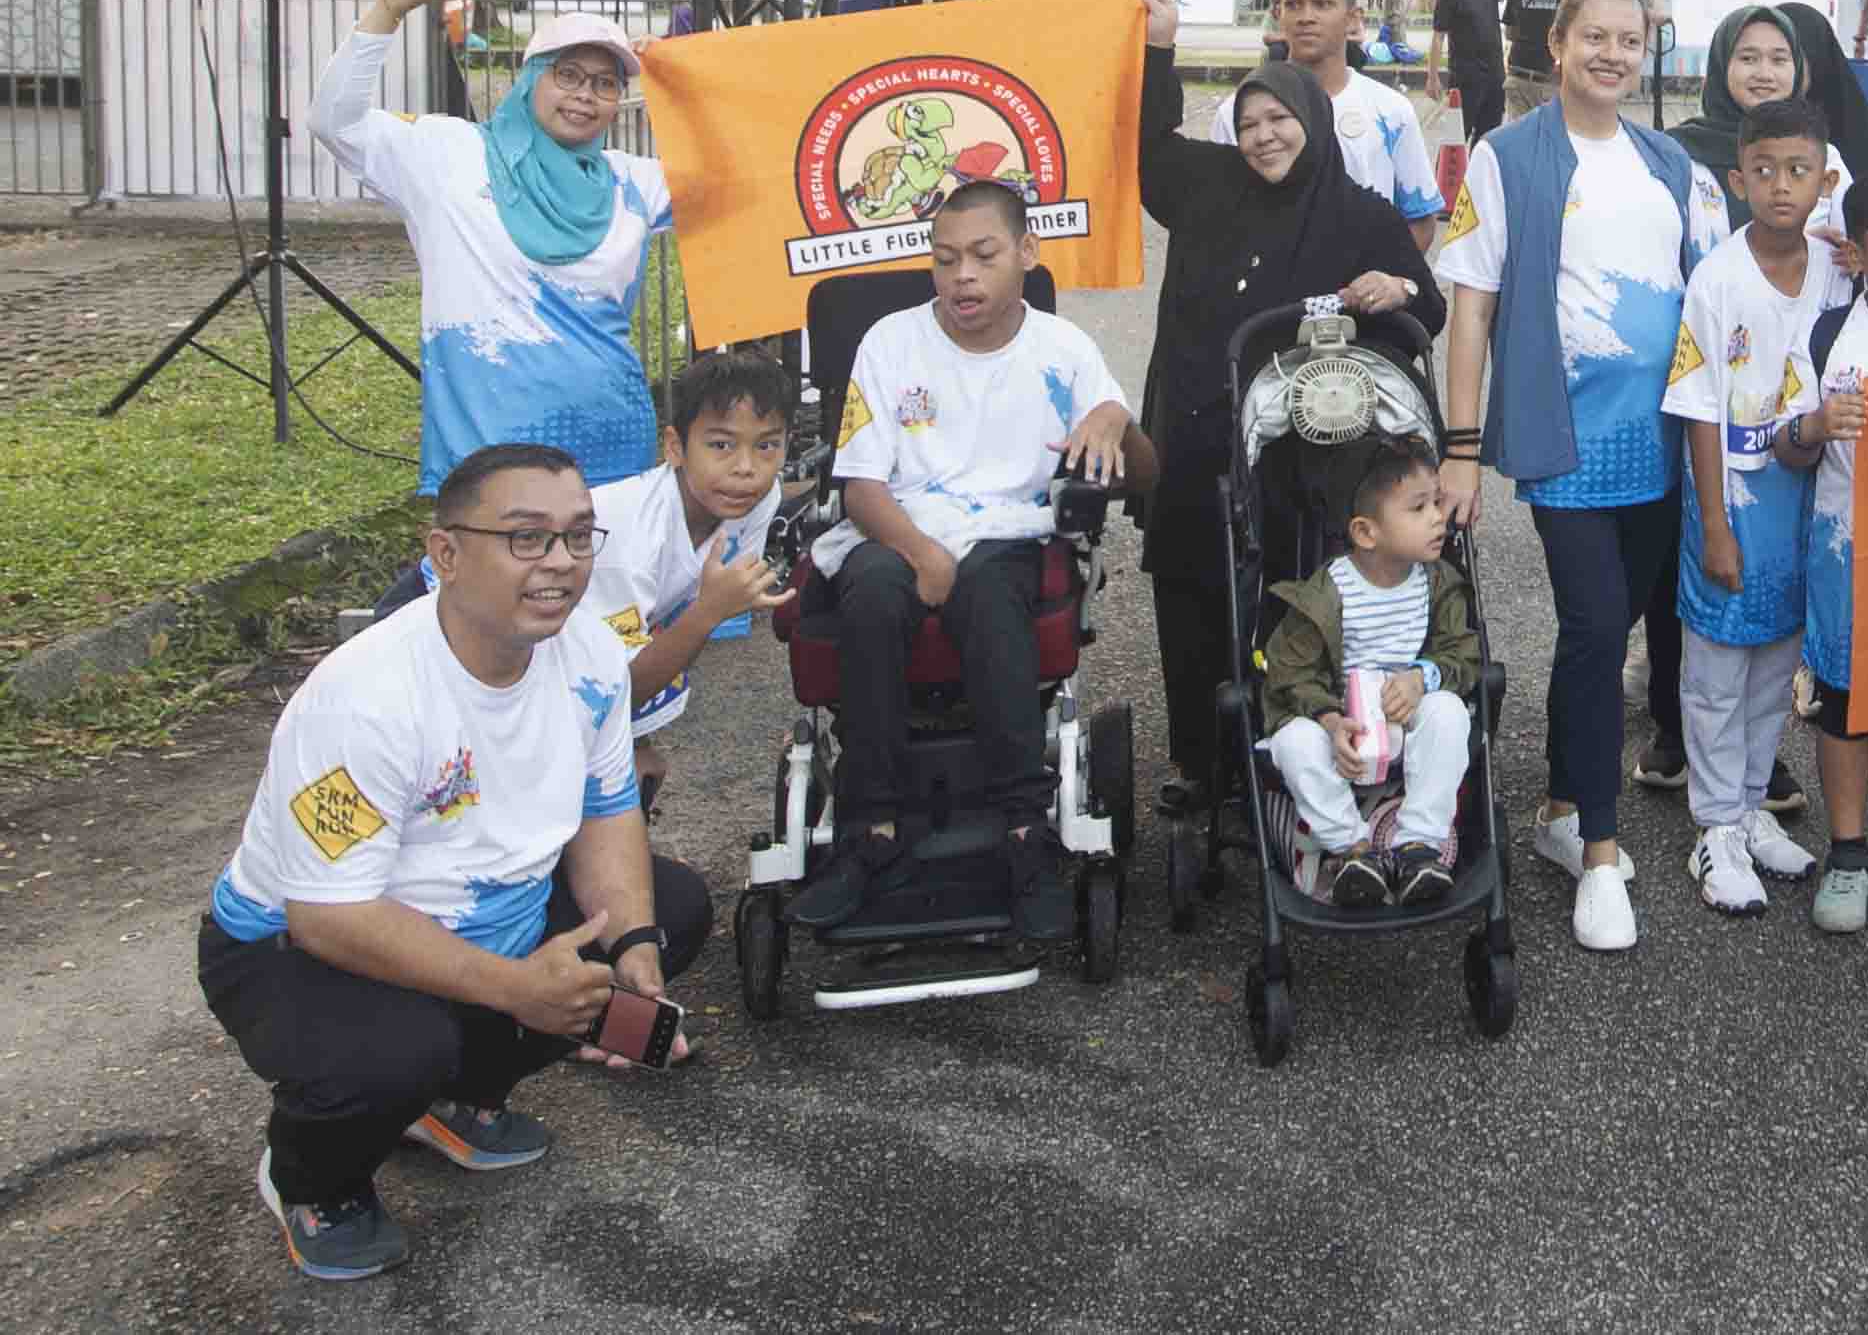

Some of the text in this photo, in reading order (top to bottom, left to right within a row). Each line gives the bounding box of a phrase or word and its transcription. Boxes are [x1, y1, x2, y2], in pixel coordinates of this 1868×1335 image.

[809, 67, 1055, 221] SPECIAL NEEDS SPECIAL HEARTS SPECIAL LOVES
[799, 210, 1079, 266] LITTLE FIGH NNER
